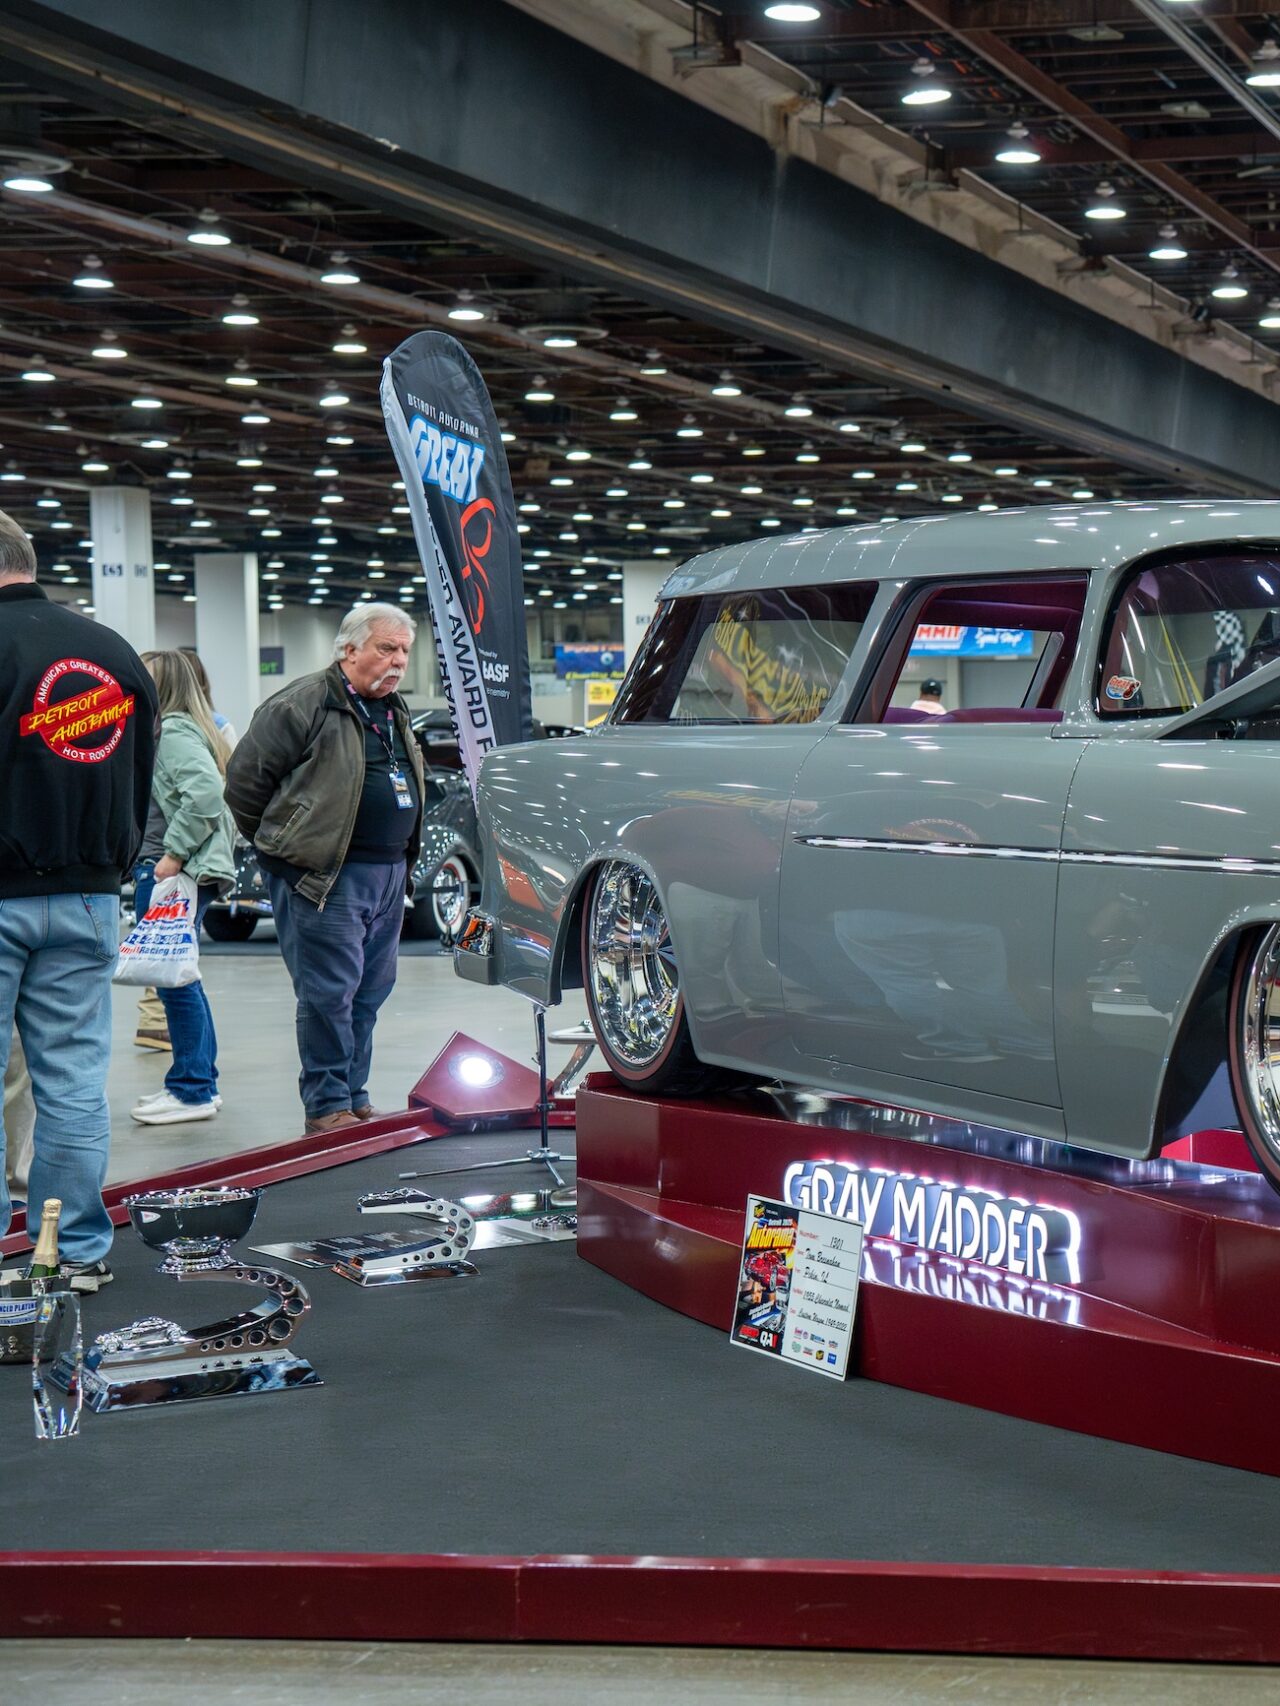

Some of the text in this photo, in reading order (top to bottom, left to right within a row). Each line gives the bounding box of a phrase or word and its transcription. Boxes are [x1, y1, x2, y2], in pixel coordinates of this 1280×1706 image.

[407, 392, 481, 438] DETROIT AUTORAMA
[409, 416, 485, 504] GREAT
[37, 660, 116, 704] AMERICA'S GREATEST
[448, 614, 489, 729] AWARD
[28, 687, 108, 730] DETROIT
[49, 698, 134, 746] AUTORAMA
[62, 727, 122, 761] HOT ROD SHOW
[747, 1221, 796, 1248] Autorama
[783, 1160, 1056, 1282] GRAY MADDER
